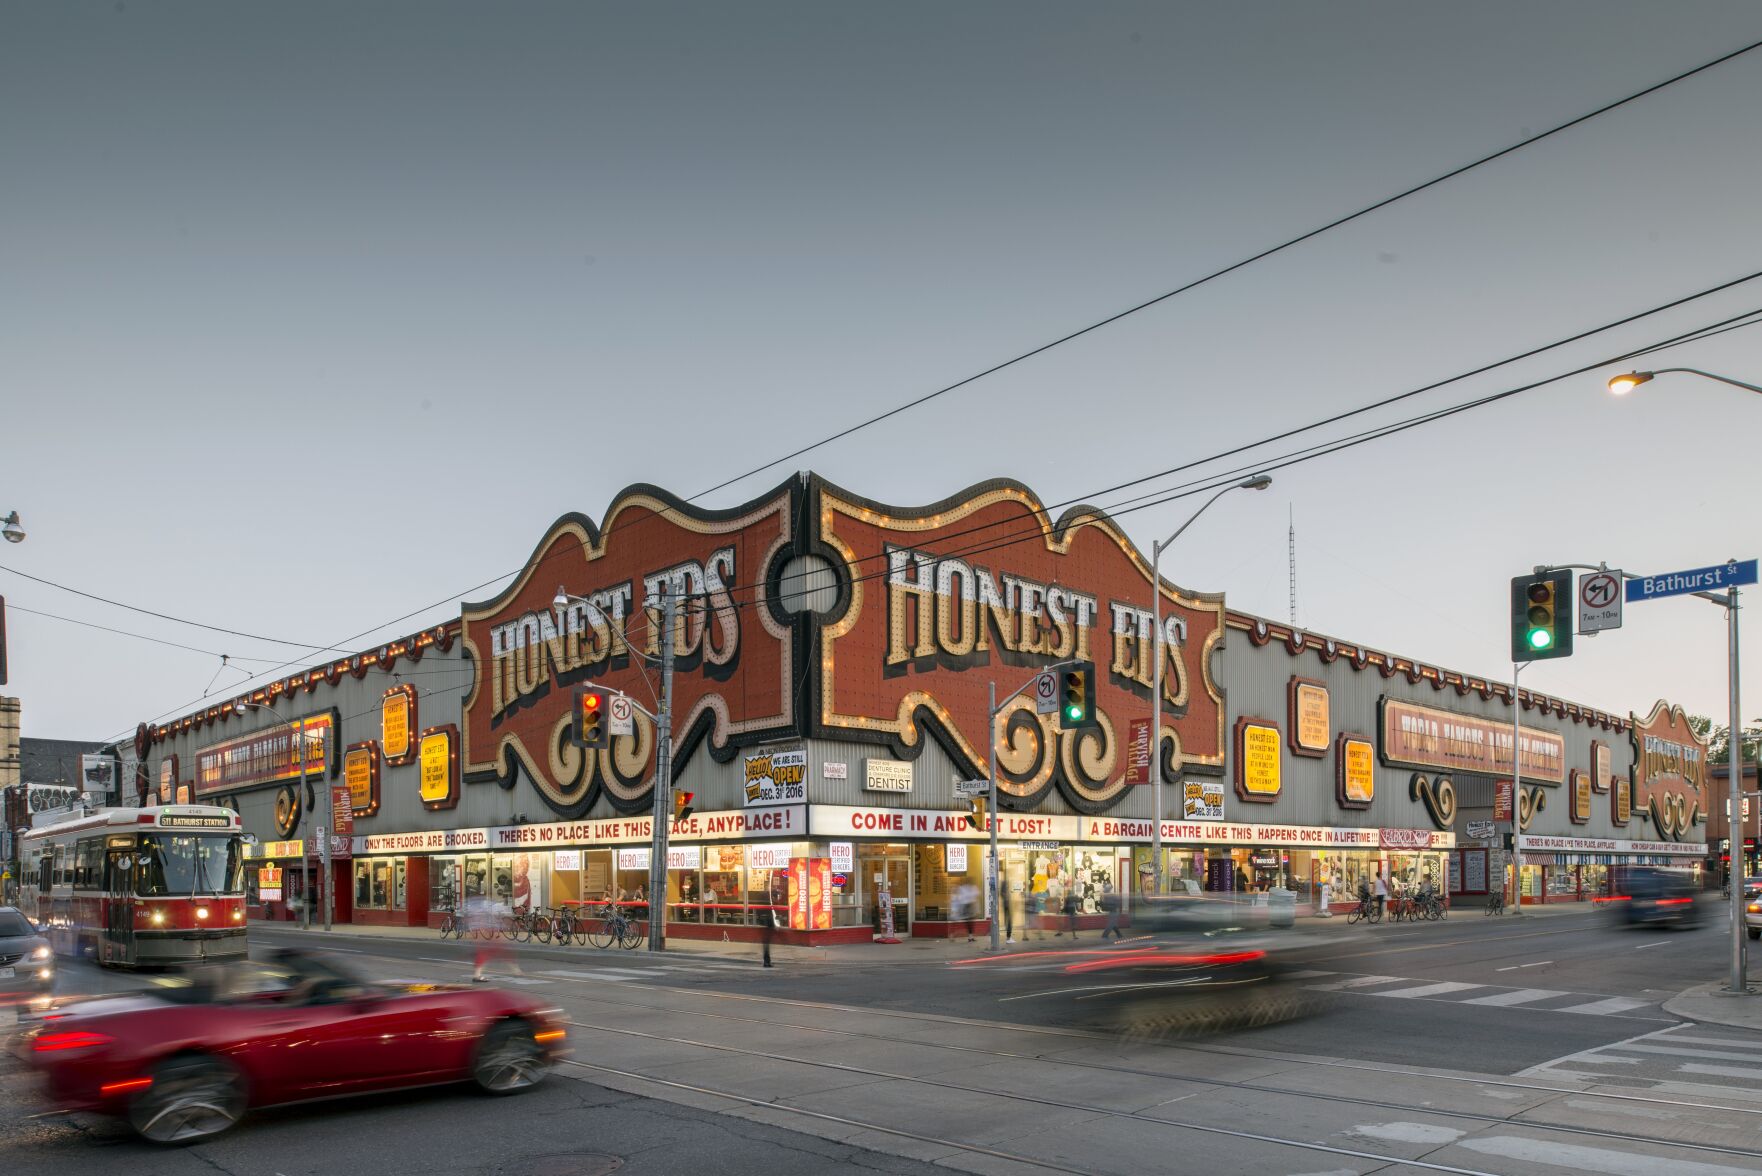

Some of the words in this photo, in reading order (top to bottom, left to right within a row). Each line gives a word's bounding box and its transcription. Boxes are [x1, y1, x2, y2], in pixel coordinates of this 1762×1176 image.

[1643, 569, 1722, 594] Bathurst
[1727, 565, 1738, 575] St
[886, 545, 1097, 665] HONEST
[1601, 610, 1618, 620] 10PM
[491, 582, 633, 719] HONEST
[1137, 726, 1149, 767] MIRVISH
[773, 757, 781, 765] WE
[782, 756, 790, 764] ARE
[791, 755, 803, 763] STILL
[868, 764, 892, 773] DENTURE
[1127, 741, 1139, 782] VILLAGE
[773, 765, 806, 787] OPEN!
[824, 766, 846, 774] PHARMACY
[868, 777, 911, 790] DENTIST
[761, 788, 775, 801] DEC.
[786, 786, 803, 798] 2016
[341, 789, 352, 822] MIRVISH
[173, 818, 203, 826] BATHURST
[334, 801, 346, 832] VILLAGE
[851, 812, 903, 830] COME
[910, 814, 927, 831] IN
[934, 815, 967, 832] AND
[1009, 818, 1052, 834] LOST!
[364, 838, 380, 852] ONLY
[382, 837, 394, 849] THE
[397, 834, 423, 848] FLOORS
[427, 833, 443, 847] ARE
[445, 830, 487, 846] CROOKED.
[499, 827, 536, 843] THERE'S
[539, 827, 552, 840] NO
[556, 824, 589, 841] PLACE
[594, 822, 620, 839] LIKE
[624, 820, 651, 837] THIS
[1090, 821, 1100, 835] A
[1104, 822, 1154, 837] BARGAIN
[1160, 824, 1202, 839] CENTRE
[1206, 826, 1227, 839] LIKE
[1231, 827, 1252, 840] THIS
[1257, 828, 1297, 841] HAPPENS
[1300, 829, 1322, 842] ONCE
[1325, 830, 1333, 842] IN
[1333, 831, 1340, 842] A
[832, 845, 850, 857] HERO
[949, 847, 965, 857] HERO
[1023, 841, 1058, 849] ENTRANCE
[1526, 838, 1543, 847] THERE'S
[1544, 839, 1550, 847] NO
[1551, 839, 1563, 848] PLACE
[1574, 840, 1583, 848] THIS
[620, 854, 637, 868] HERO
[667, 852, 685, 868] HERO
[753, 850, 774, 867] HERO
[799, 890, 807, 912] HERO
[823, 889, 831, 912] HERO
